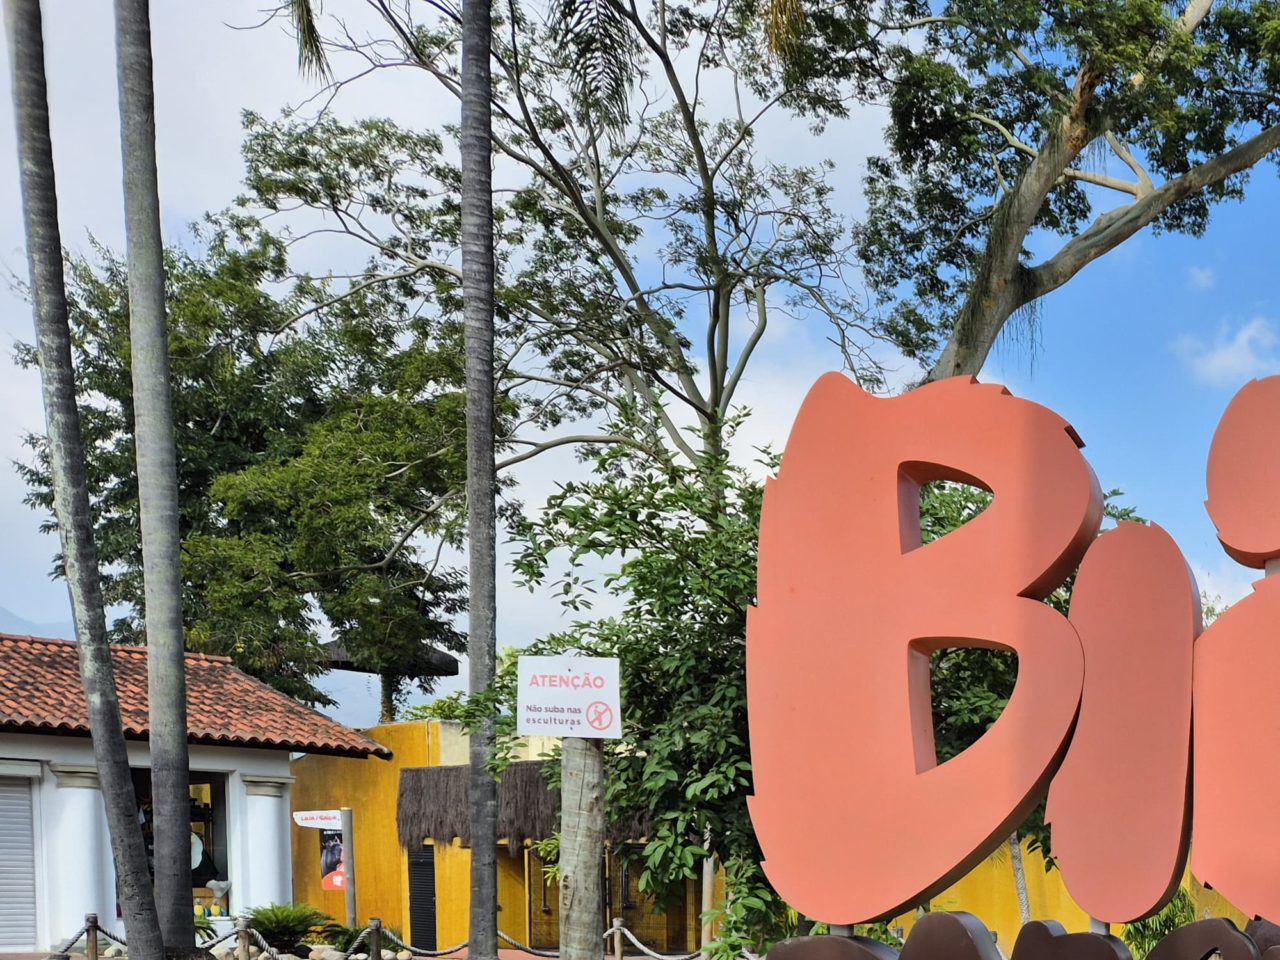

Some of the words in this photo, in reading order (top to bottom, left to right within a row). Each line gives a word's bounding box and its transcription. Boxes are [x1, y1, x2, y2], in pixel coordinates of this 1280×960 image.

[529, 672, 605, 690] ATENÇÃO
[526, 704, 542, 713] Não
[544, 705, 565, 714] suba
[526, 716, 581, 726] esculturas
